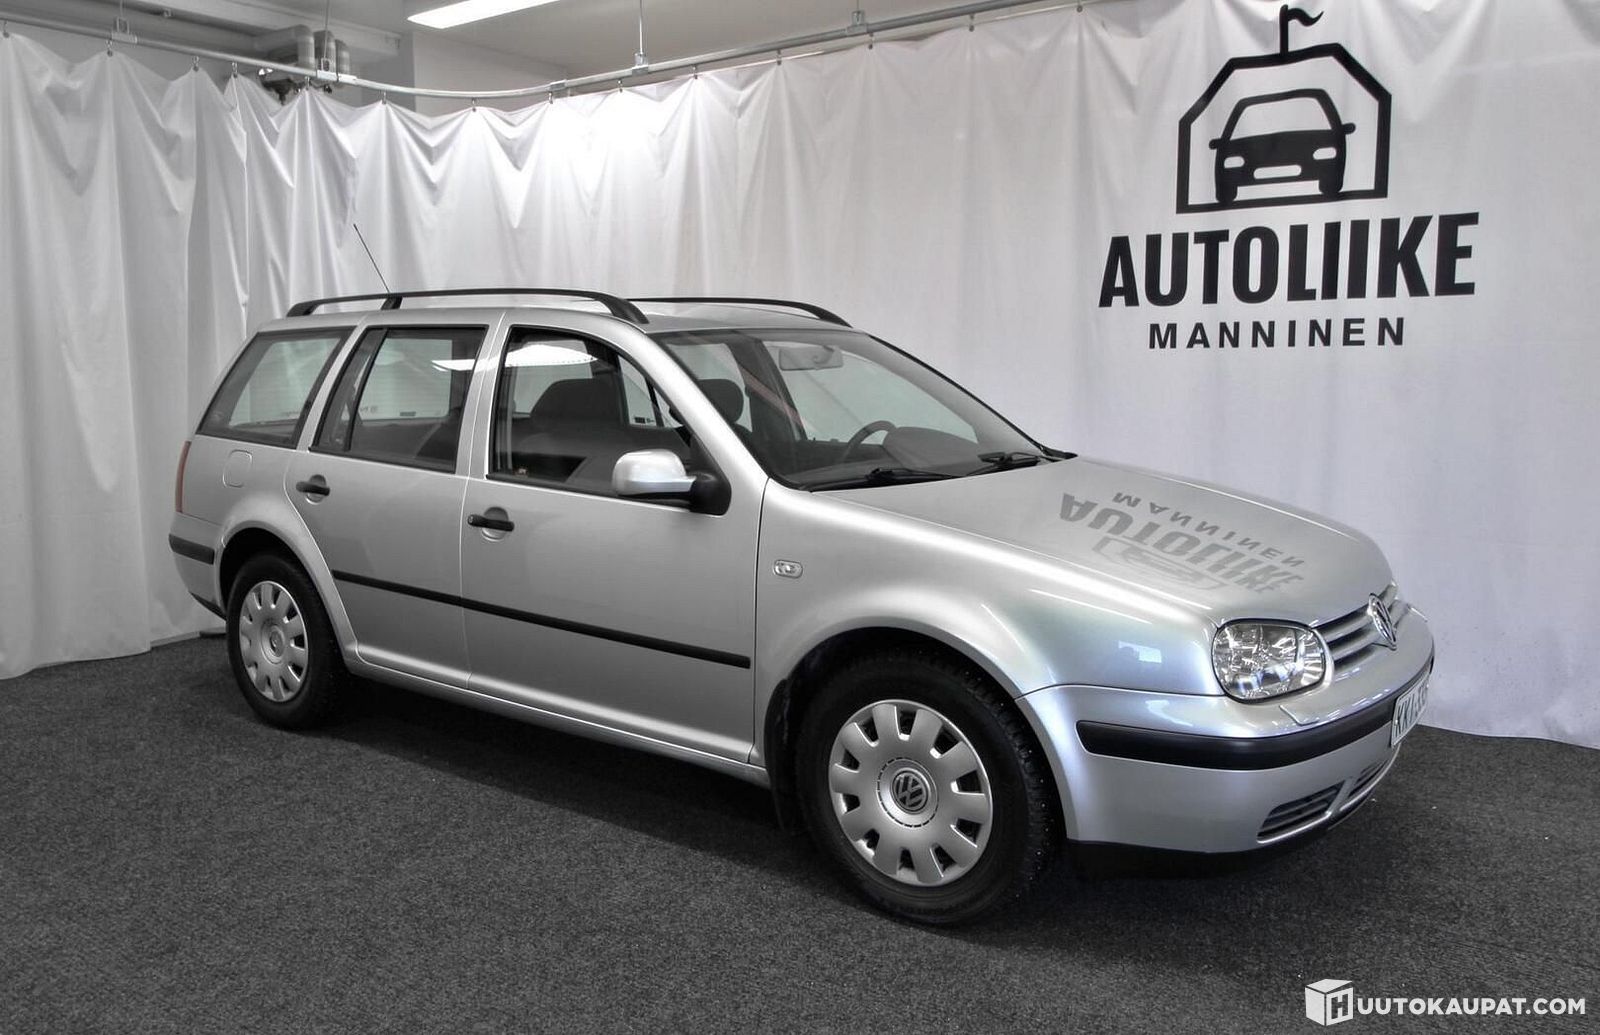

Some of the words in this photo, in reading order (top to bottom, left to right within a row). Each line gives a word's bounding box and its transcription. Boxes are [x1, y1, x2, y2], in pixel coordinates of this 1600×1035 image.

[1098, 212, 1480, 308] AUTOLIIKE
[1148, 317, 1404, 349] MANNINEN
[895, 773, 925, 809] VW
